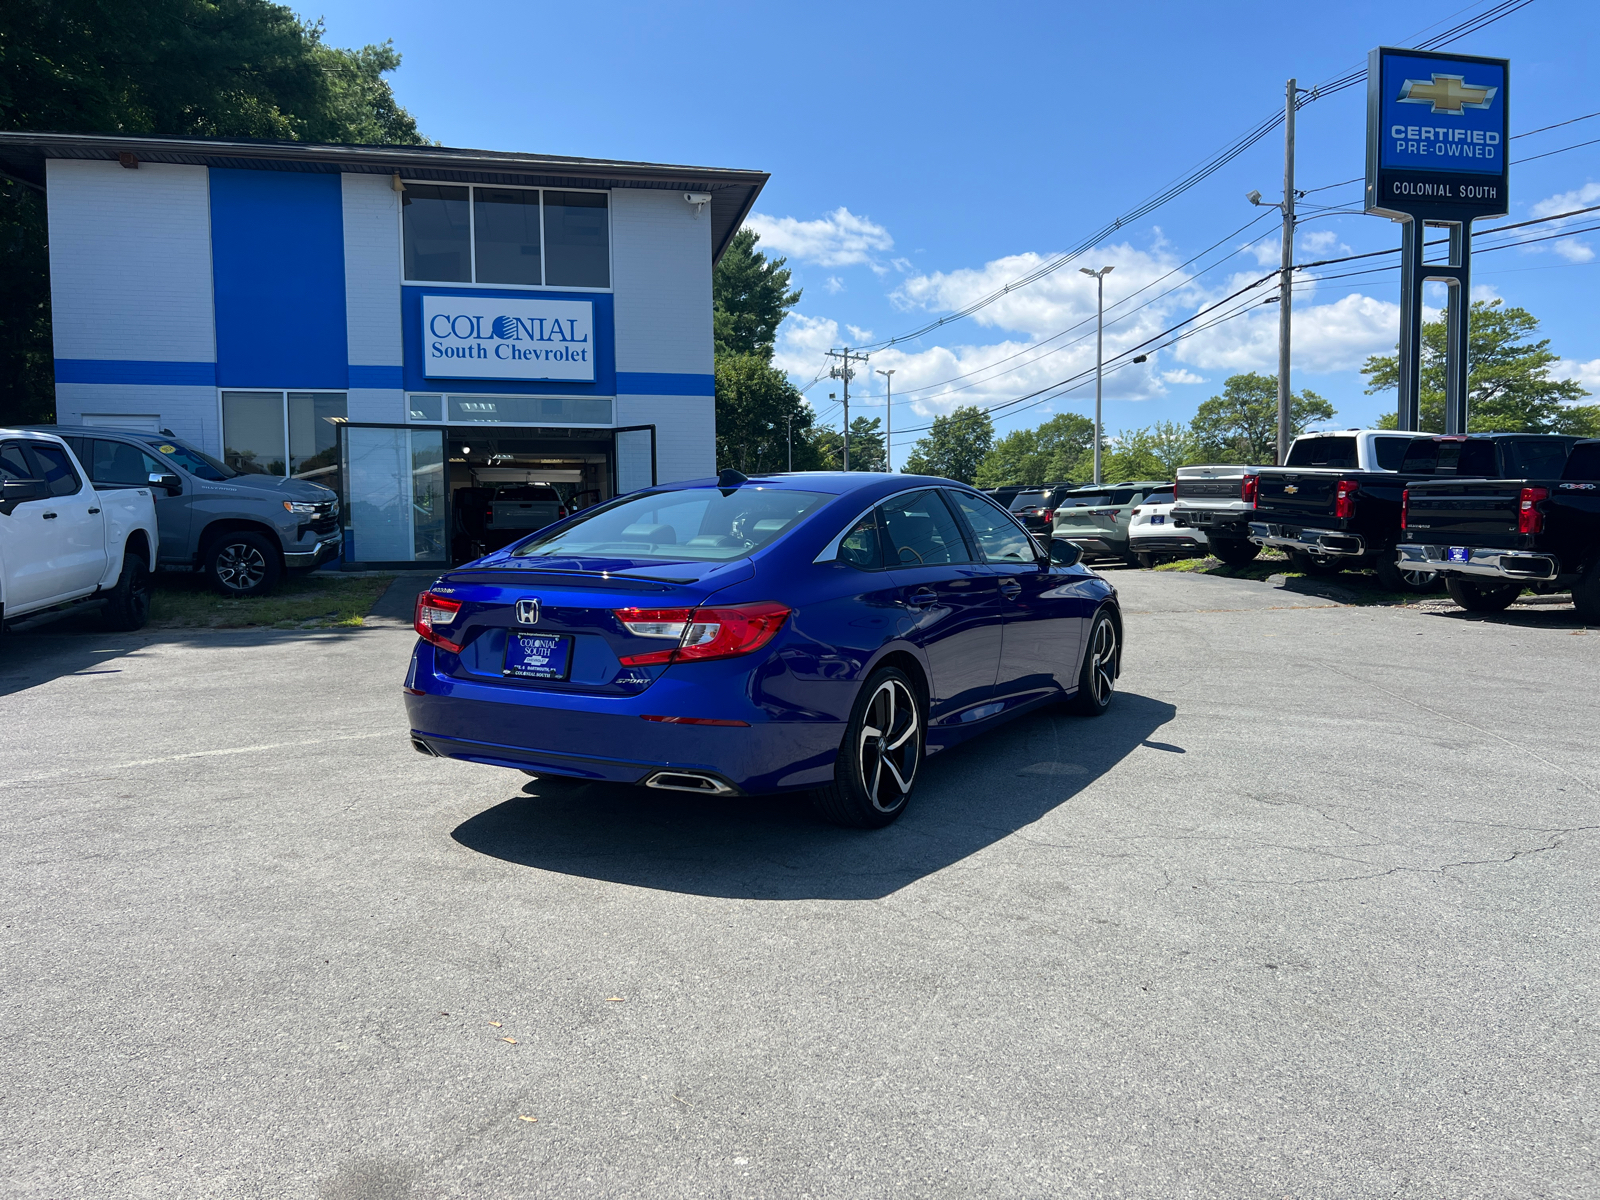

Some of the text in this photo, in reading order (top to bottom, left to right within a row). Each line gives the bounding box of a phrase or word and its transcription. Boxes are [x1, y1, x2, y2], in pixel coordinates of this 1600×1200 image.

[1391, 125, 1500, 145] CERTIFIED
[1396, 141, 1495, 158] PRE-OWNED
[1393, 181, 1497, 199] COLONIAL SOUTH
[429, 314, 588, 343] COLONIAL
[431, 341, 588, 362] South Chevrolet
[520, 639, 557, 649] COLONIAL
[524, 647, 551, 656] SOUTH
